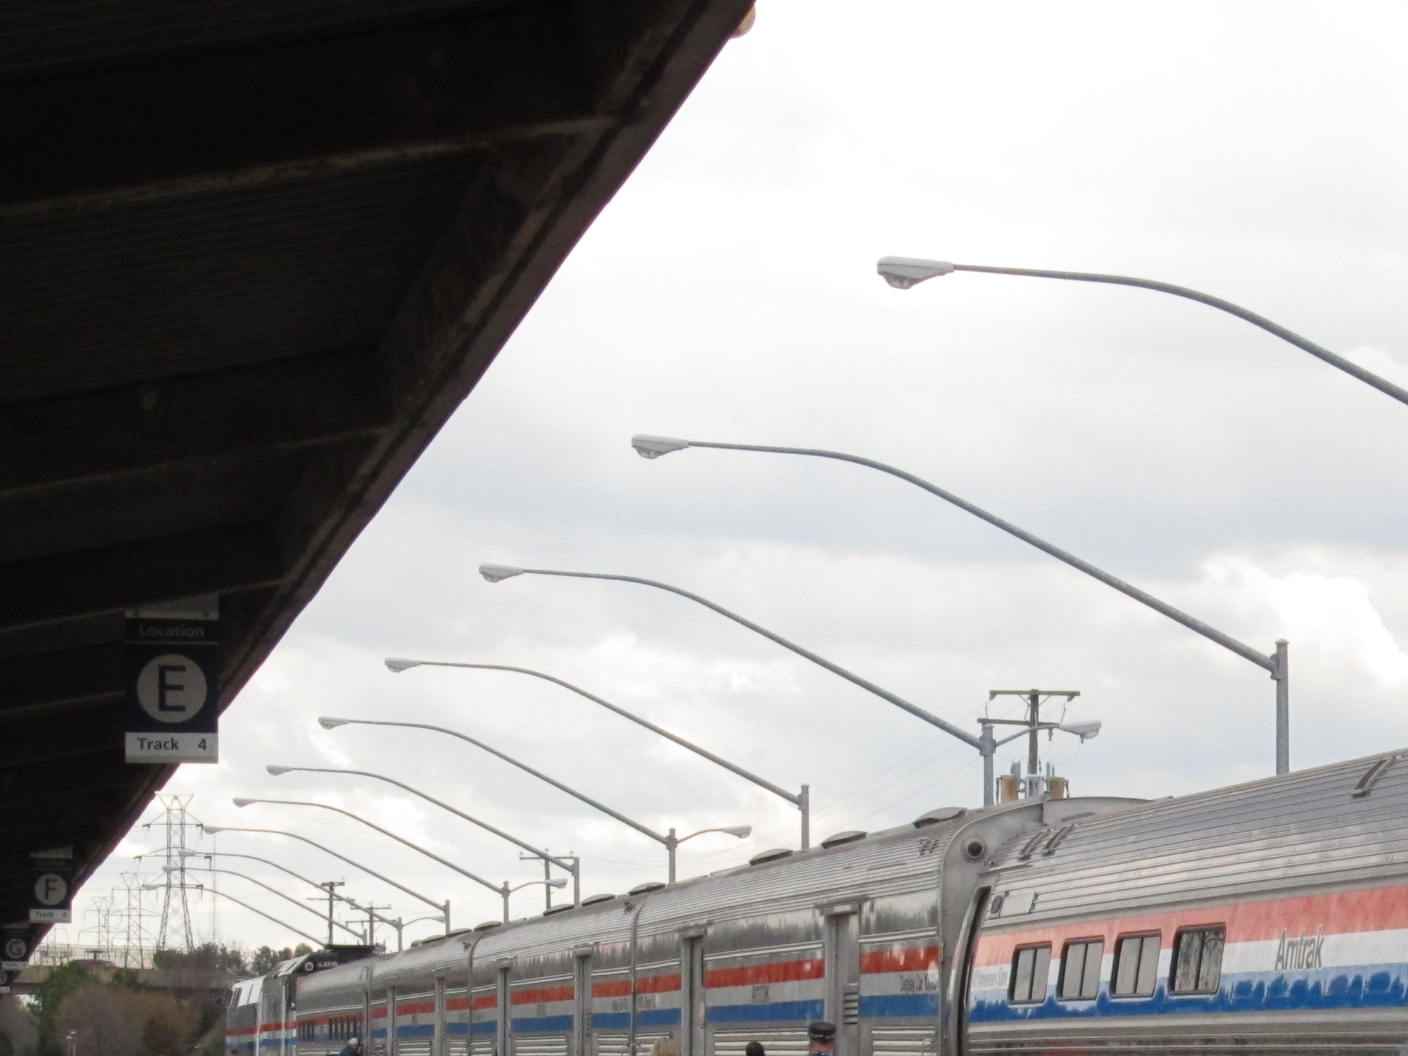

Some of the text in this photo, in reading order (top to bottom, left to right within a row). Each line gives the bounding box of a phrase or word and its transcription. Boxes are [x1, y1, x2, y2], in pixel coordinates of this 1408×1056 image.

[139, 622, 205, 638] Location
[158, 664, 187, 712] E
[137, 737, 208, 752] Track 4
[46, 879, 57, 901] F
[1275, 928, 1325, 970] Amtrak
